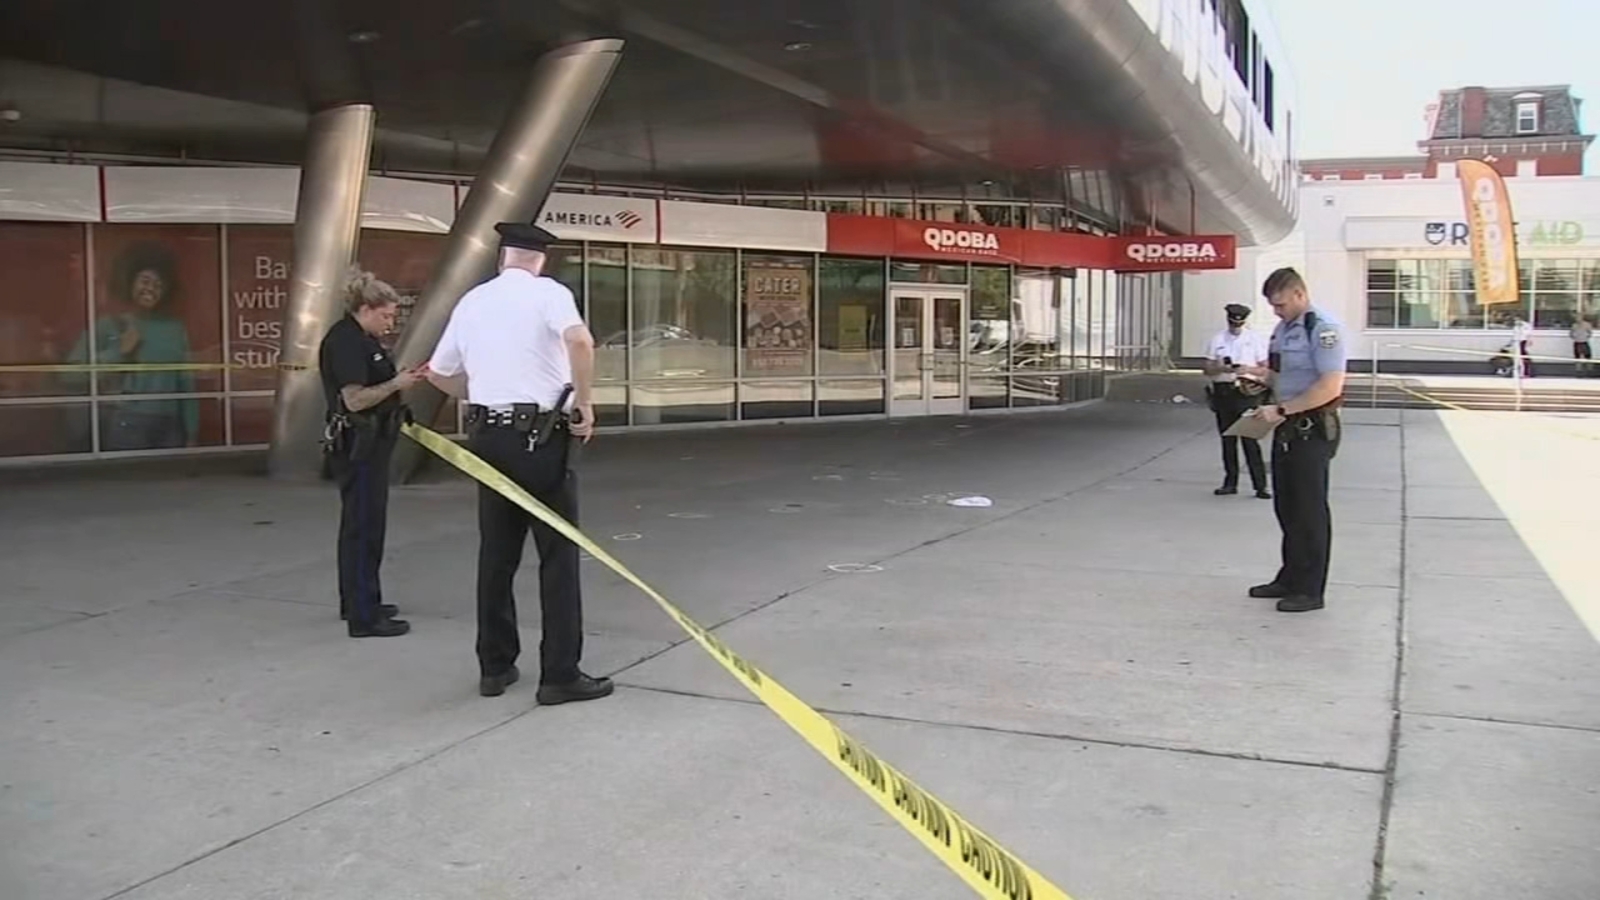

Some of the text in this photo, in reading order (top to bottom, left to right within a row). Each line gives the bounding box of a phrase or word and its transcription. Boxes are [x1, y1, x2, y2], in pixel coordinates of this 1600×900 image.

[545, 211, 612, 226] AMERICA
[924, 227, 999, 251] QDOBA
[1531, 221, 1583, 245] AID
[1127, 243, 1217, 262] QDOBA
[255, 255, 288, 280] Ba
[754, 278, 801, 294] CATER
[238, 315, 282, 339] bes
